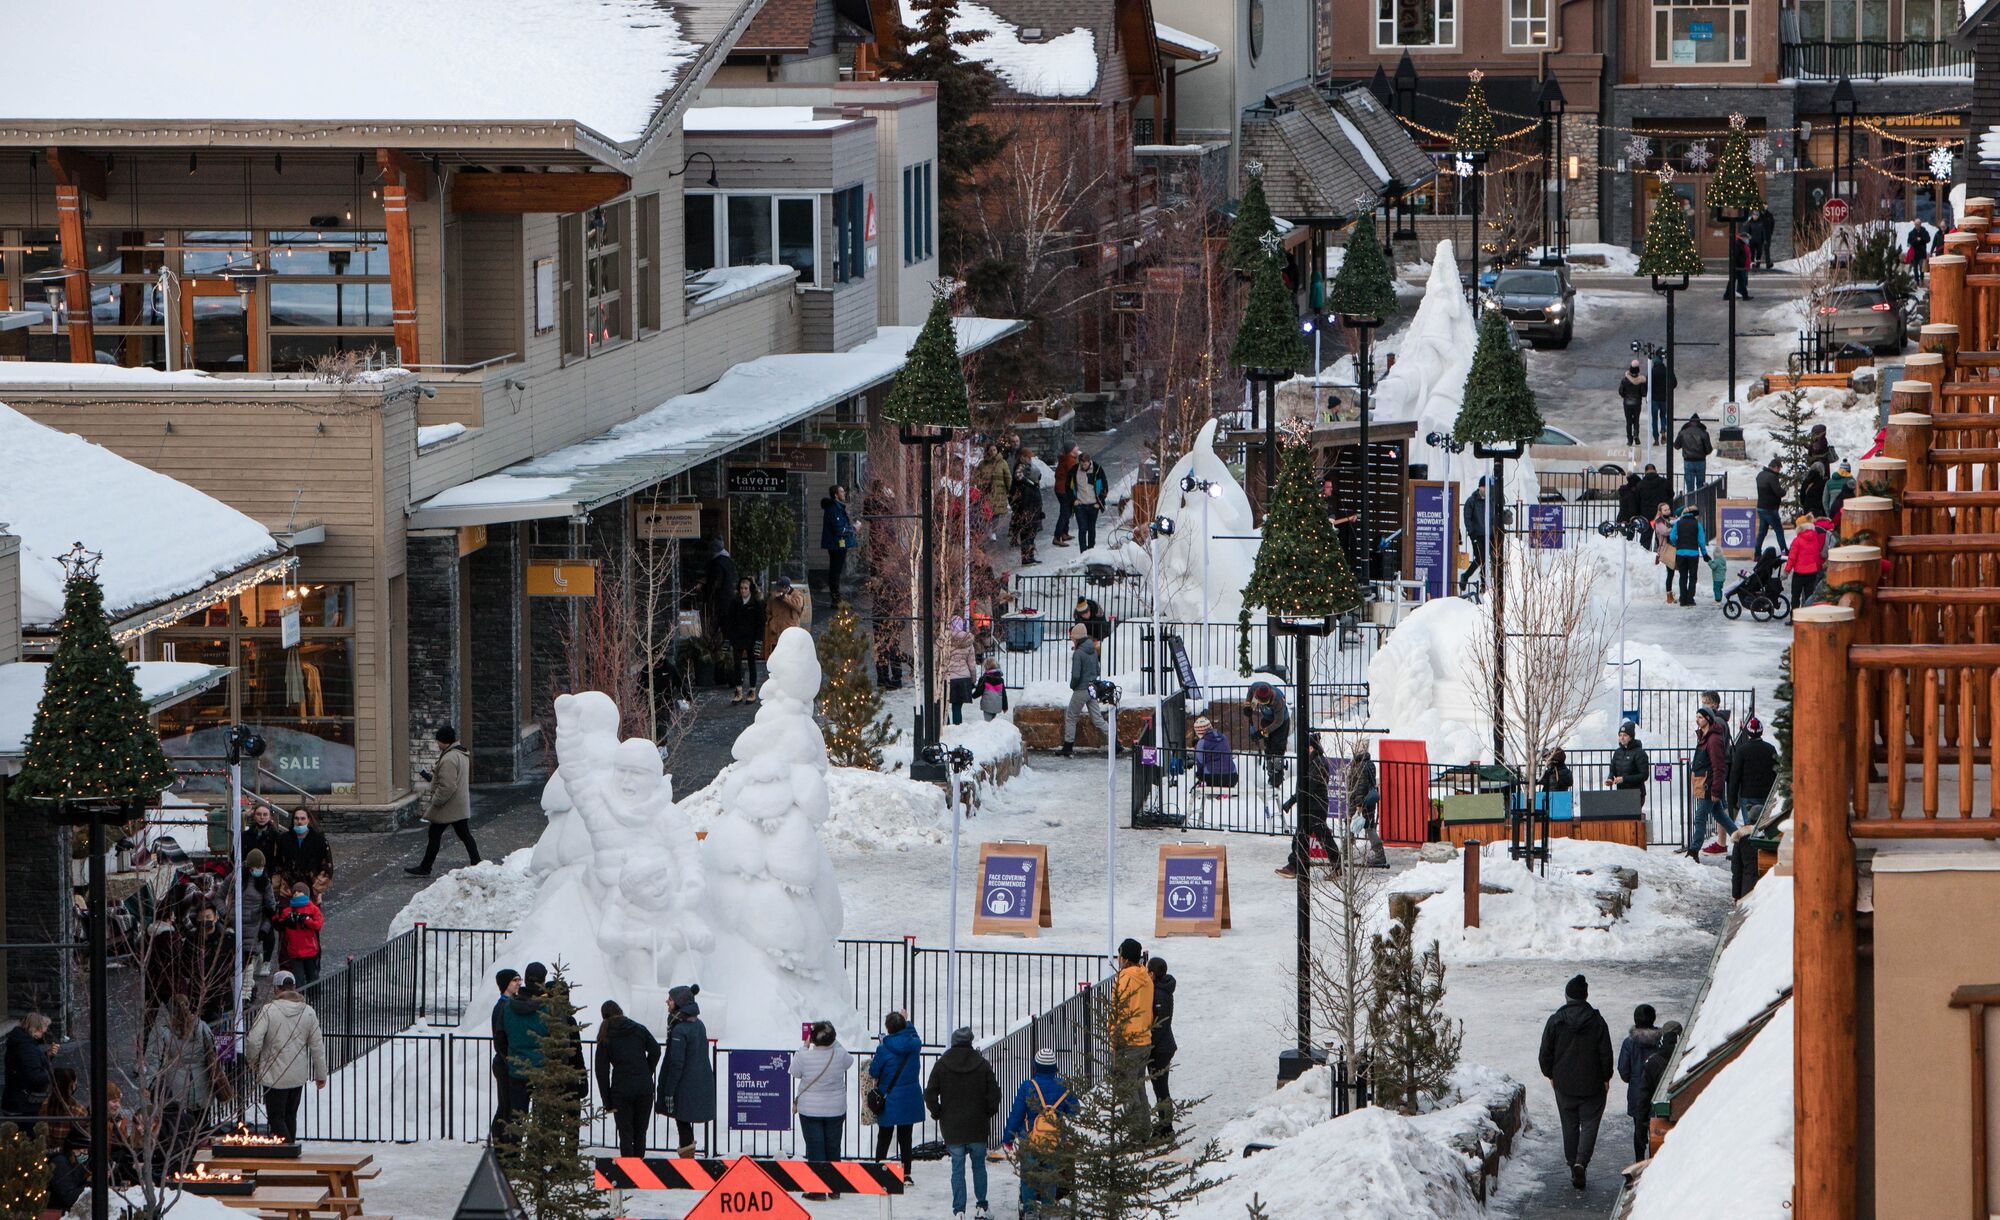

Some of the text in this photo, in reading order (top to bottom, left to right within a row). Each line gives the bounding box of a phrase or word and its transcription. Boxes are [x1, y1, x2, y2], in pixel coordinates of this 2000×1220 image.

[1825, 207, 1847, 217] STOP
[736, 476, 778, 485] tavern
[279, 756, 321, 770] SALE
[720, 1190, 774, 1213] ROAD
